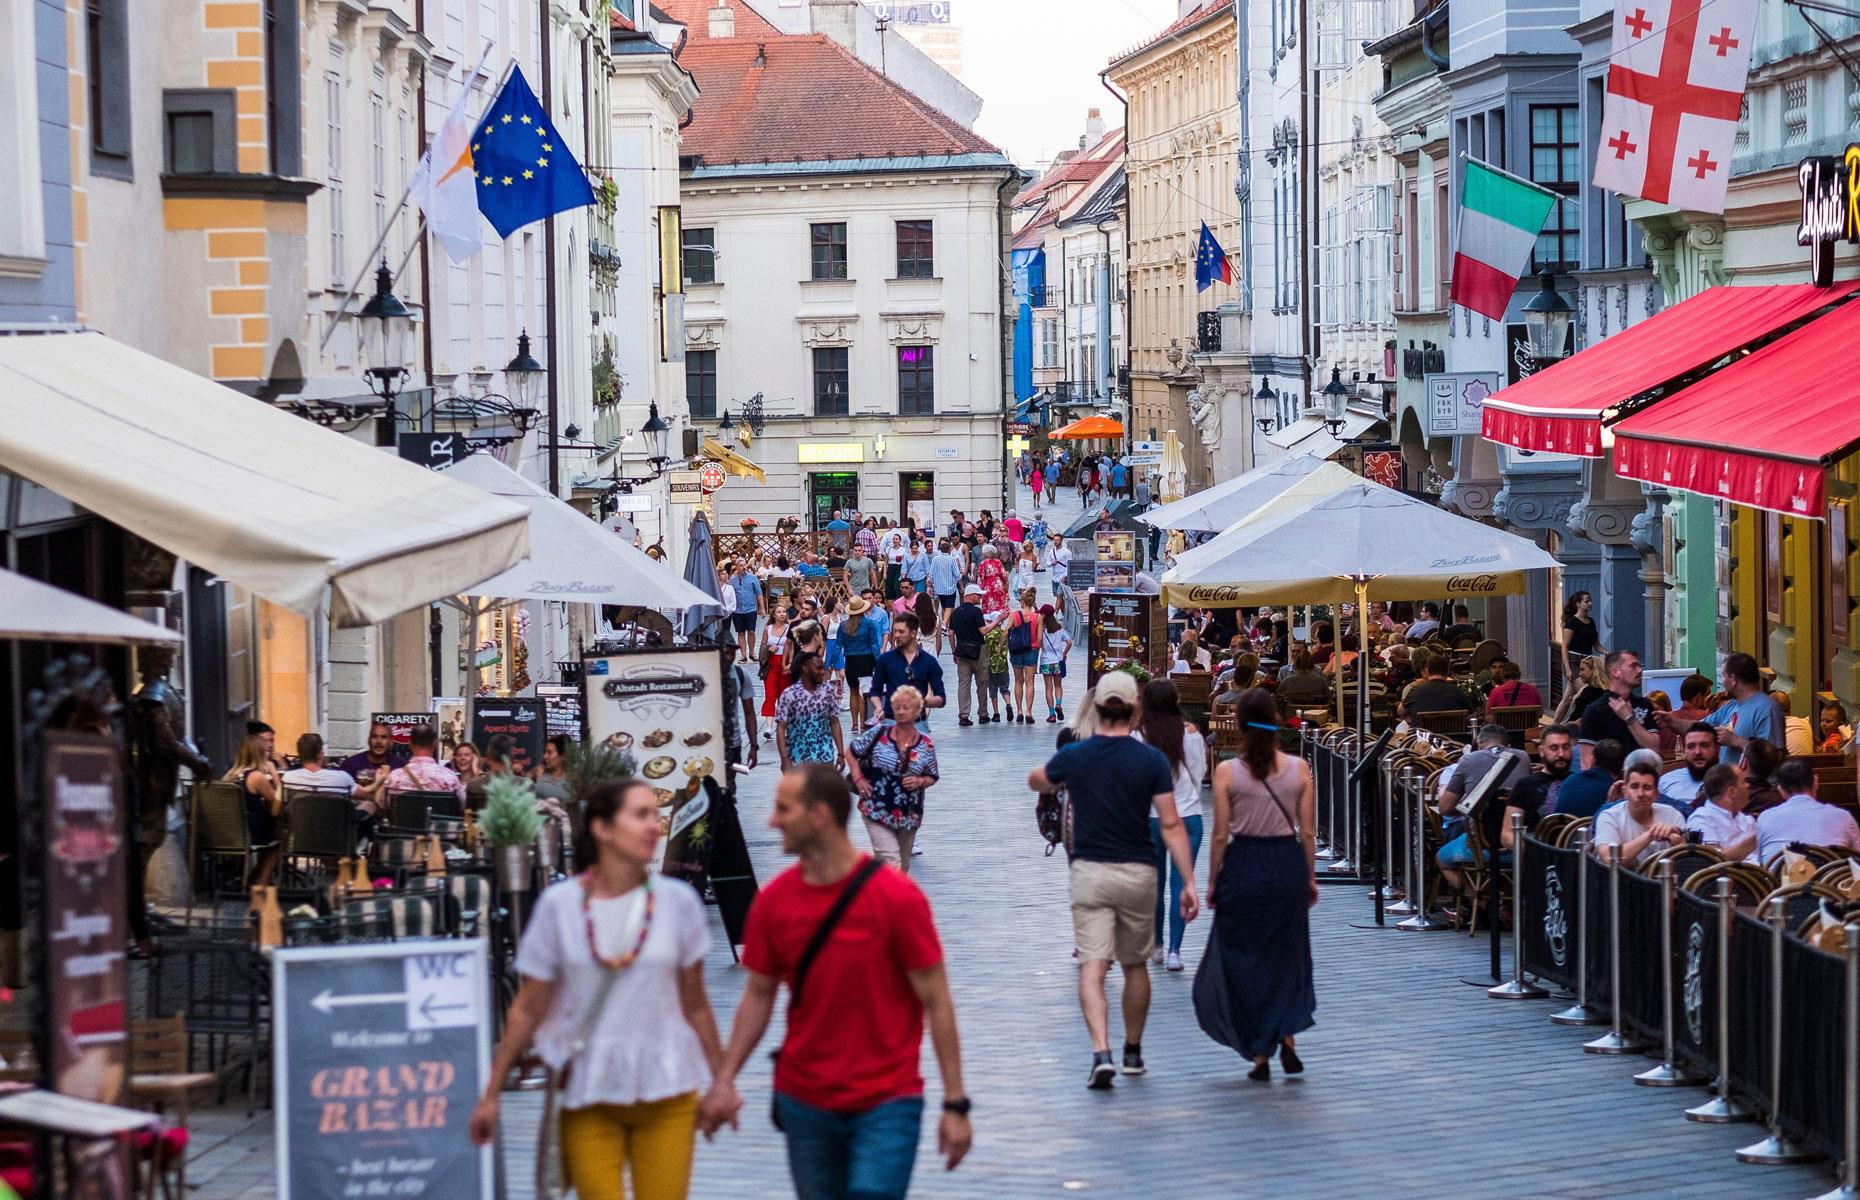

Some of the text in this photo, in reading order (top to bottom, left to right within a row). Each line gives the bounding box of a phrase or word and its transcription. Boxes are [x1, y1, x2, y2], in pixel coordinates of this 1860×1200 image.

[671, 484, 701, 492] SOUVENIRS
[615, 682, 693, 693] Altstadt Restaurant
[376, 715, 431, 724] CIGARETY
[416, 956, 466, 979] WC
[310, 1060, 455, 1099] GRAND
